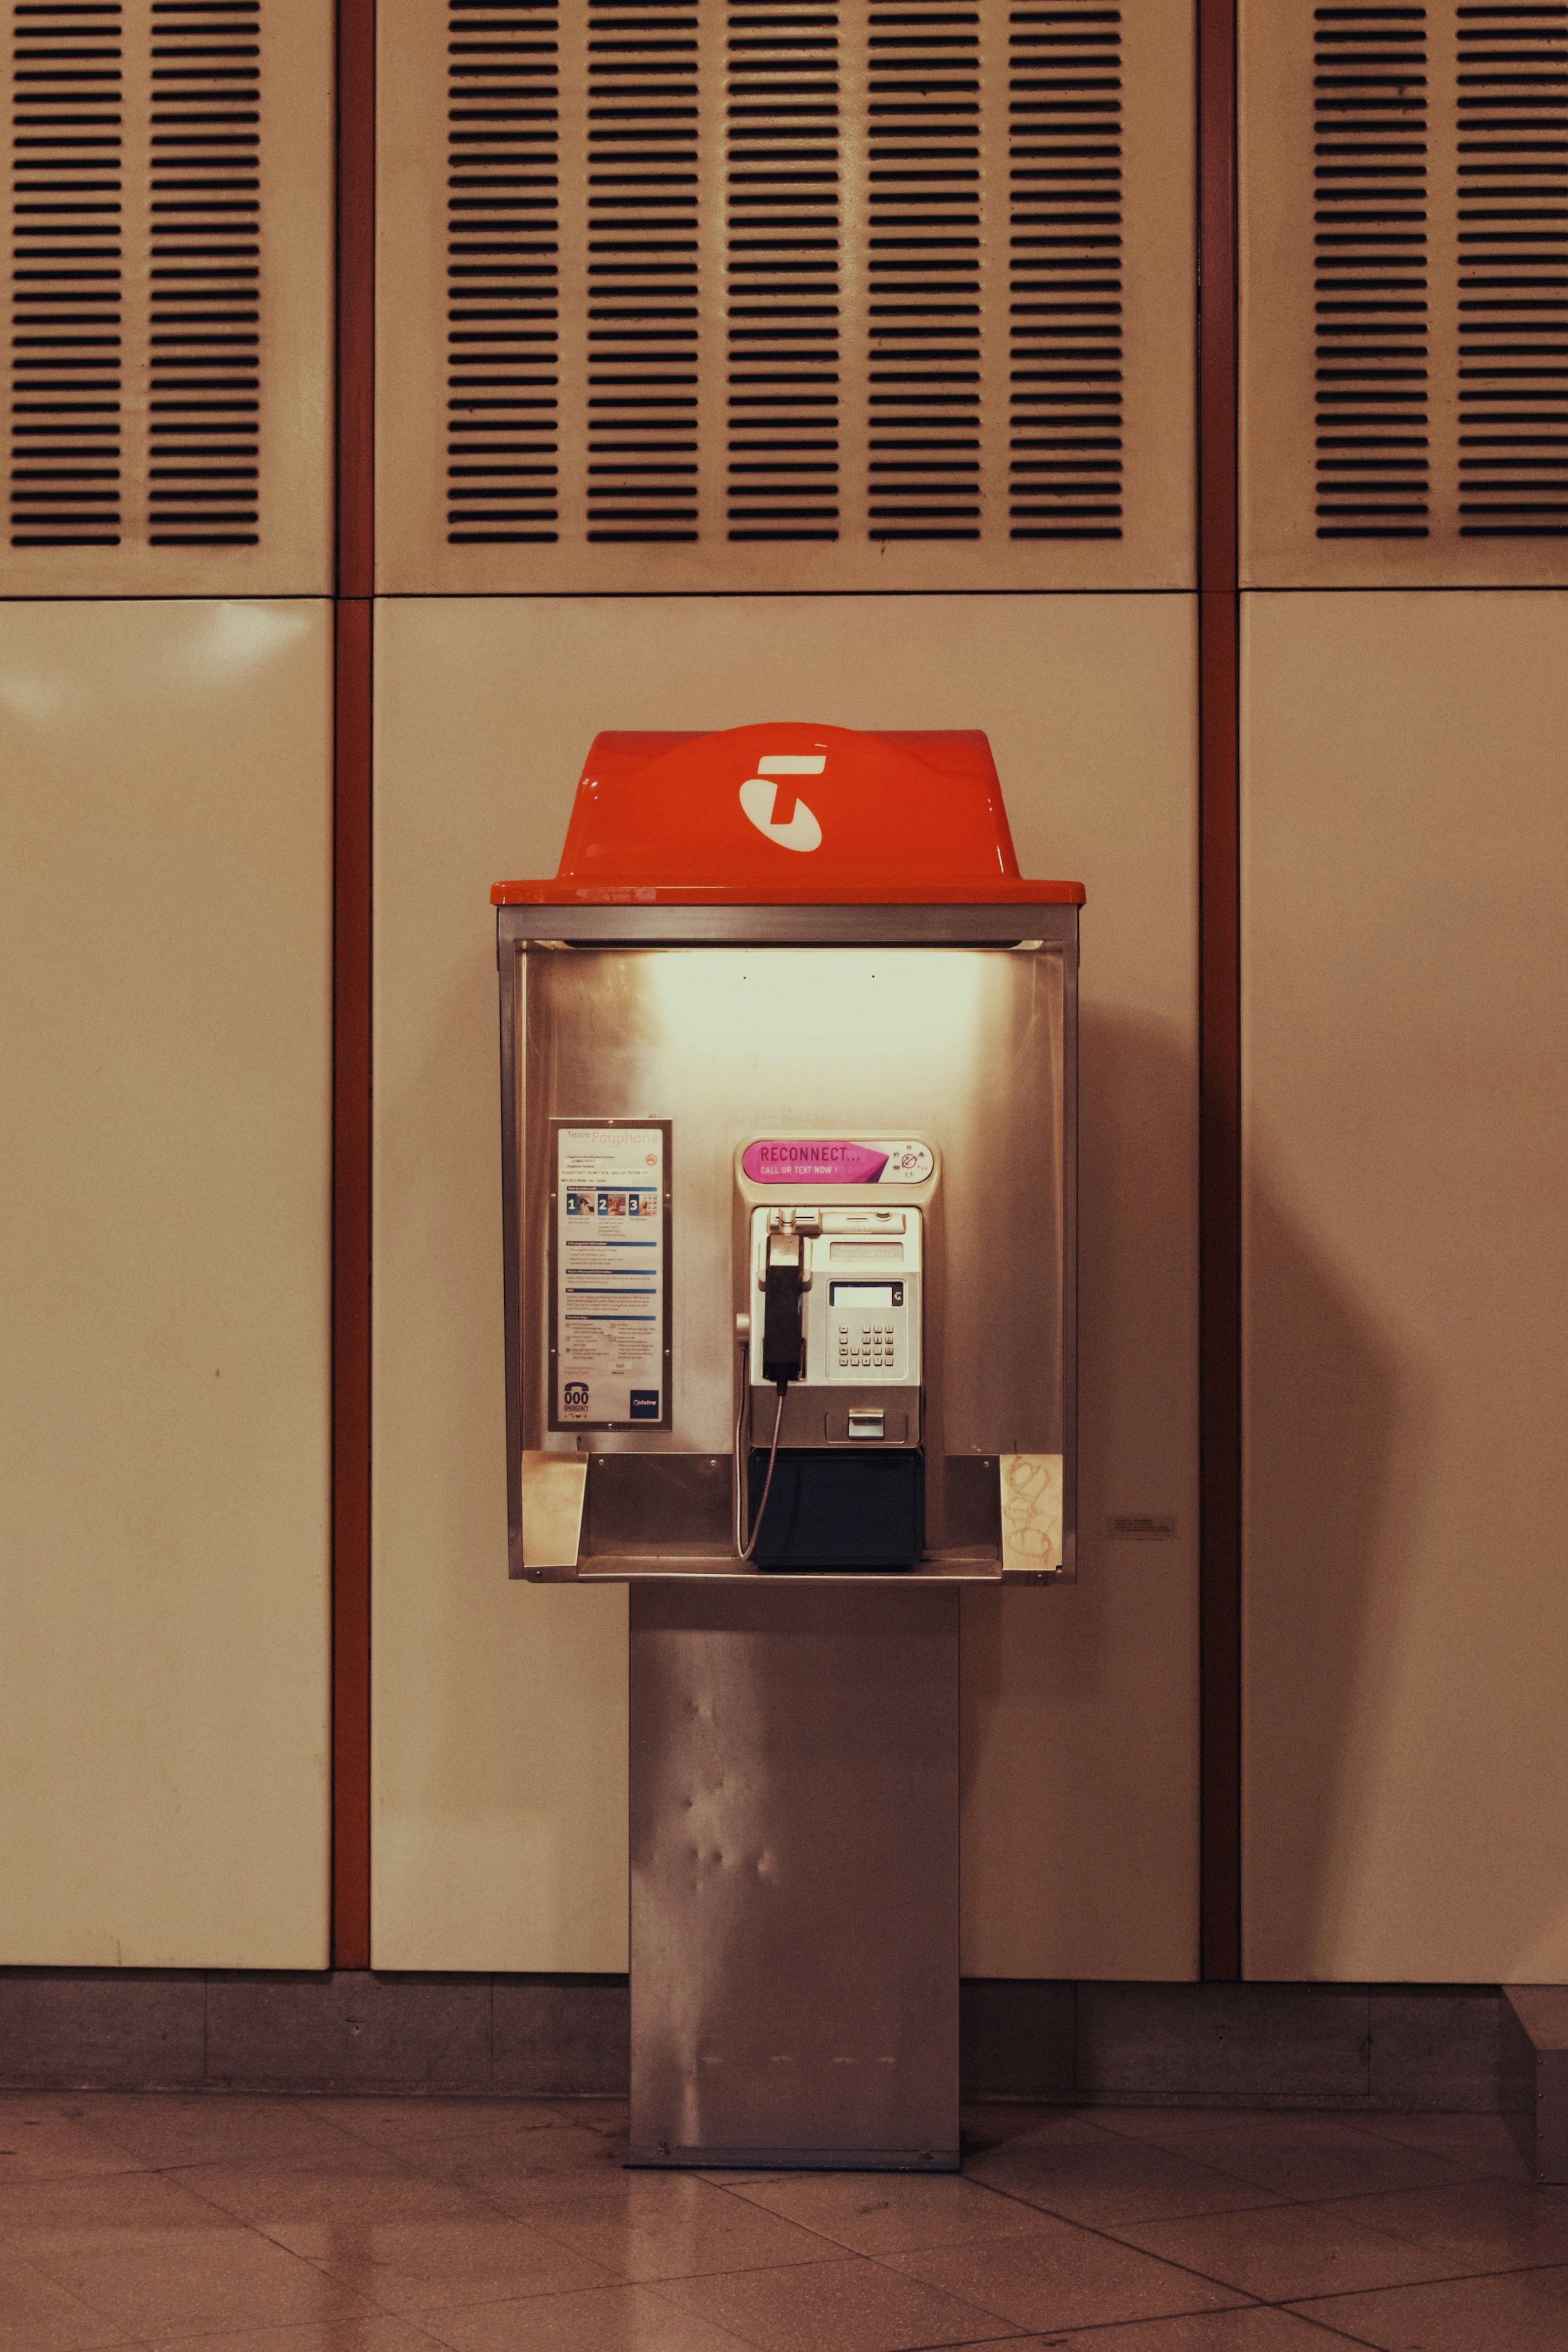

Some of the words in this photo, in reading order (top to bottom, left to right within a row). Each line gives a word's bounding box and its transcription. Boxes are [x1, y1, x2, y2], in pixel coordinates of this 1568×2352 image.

[592, 1131, 659, 1147] Payphone
[761, 1147, 861, 1161] RECONNECT...
[761, 1166, 779, 1174] CALL
[782, 1166, 792, 1174] OR
[795, 1166, 811, 1174] TEXT
[814, 1166, 831, 1174] NOW
[568, 1199, 576, 1209] 1
[599, 1199, 607, 1210] 2
[630, 1200, 638, 1210] 3
[564, 1392, 589, 1404] 000
